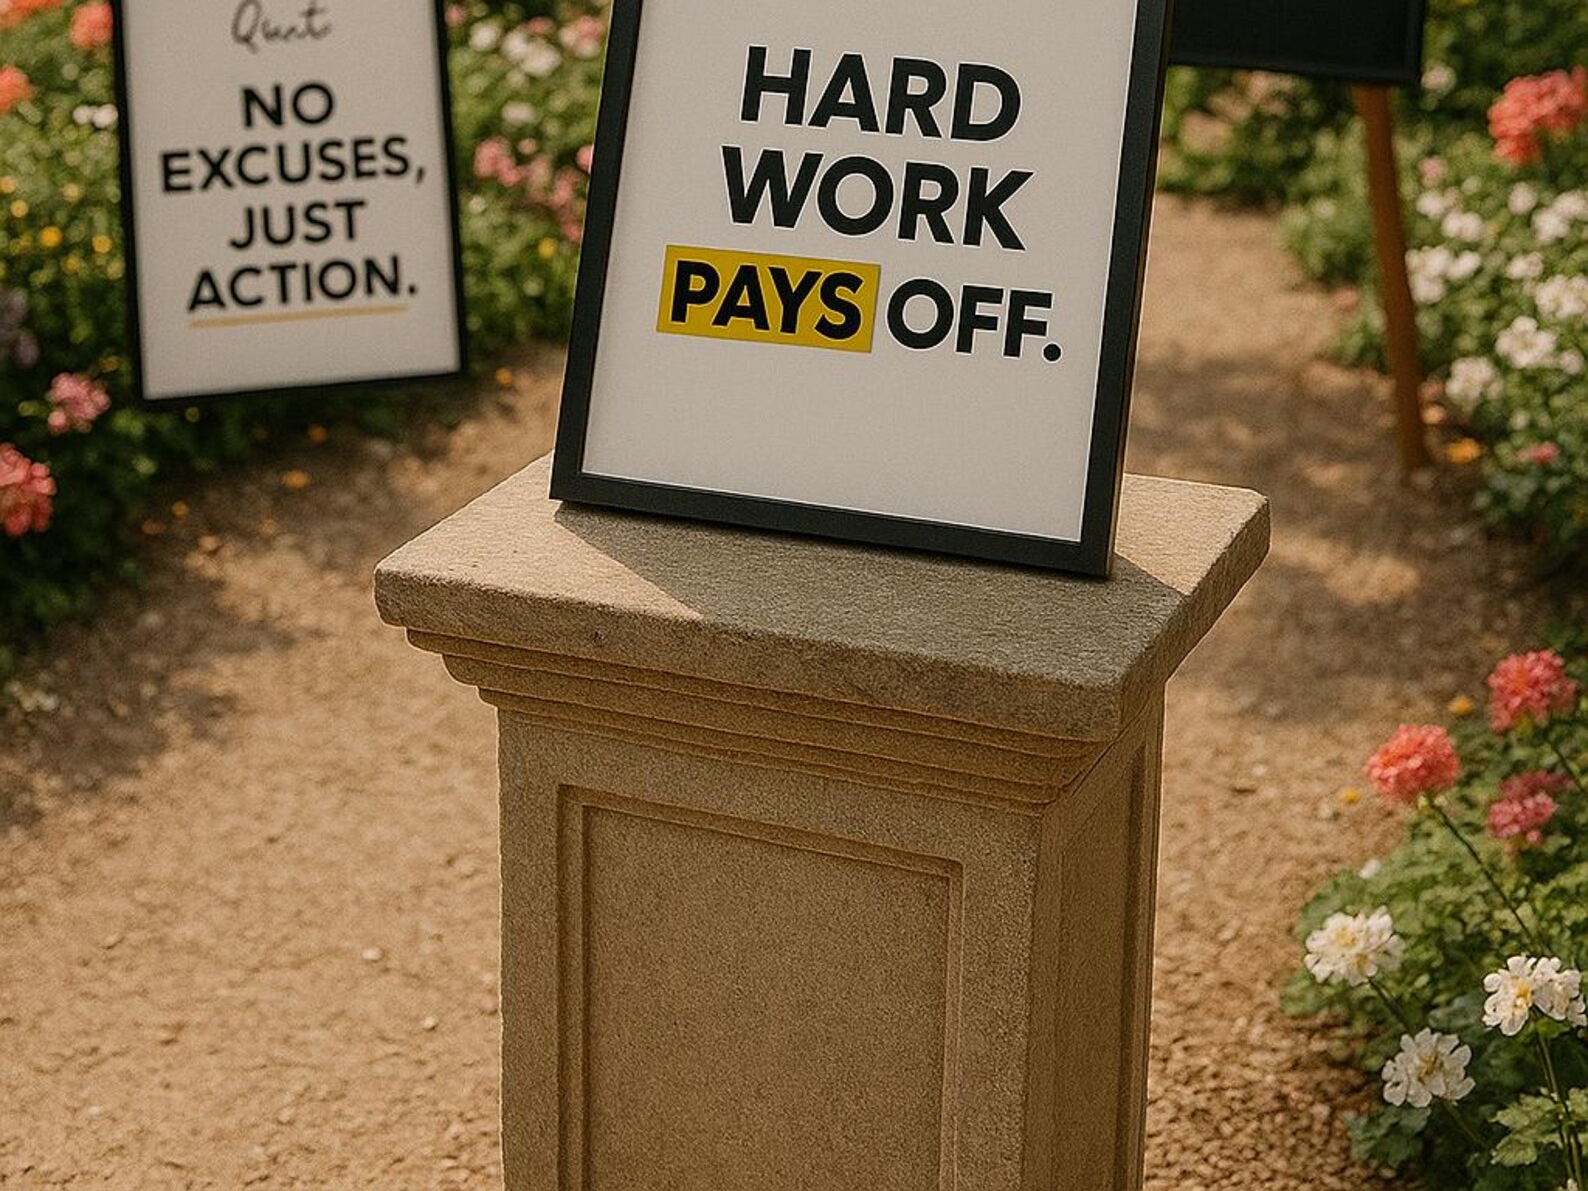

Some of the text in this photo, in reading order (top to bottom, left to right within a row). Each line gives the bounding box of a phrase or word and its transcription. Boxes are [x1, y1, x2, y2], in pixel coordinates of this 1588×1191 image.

[241, 81, 336, 130] NO
[741, 46, 1021, 142] HARD
[159, 134, 426, 194] EXCUSES,
[228, 198, 367, 252] JUST
[722, 145, 1034, 251] WORK
[186, 253, 419, 314] ACTION.
[670, 259, 1062, 362] PAYS OFF.
